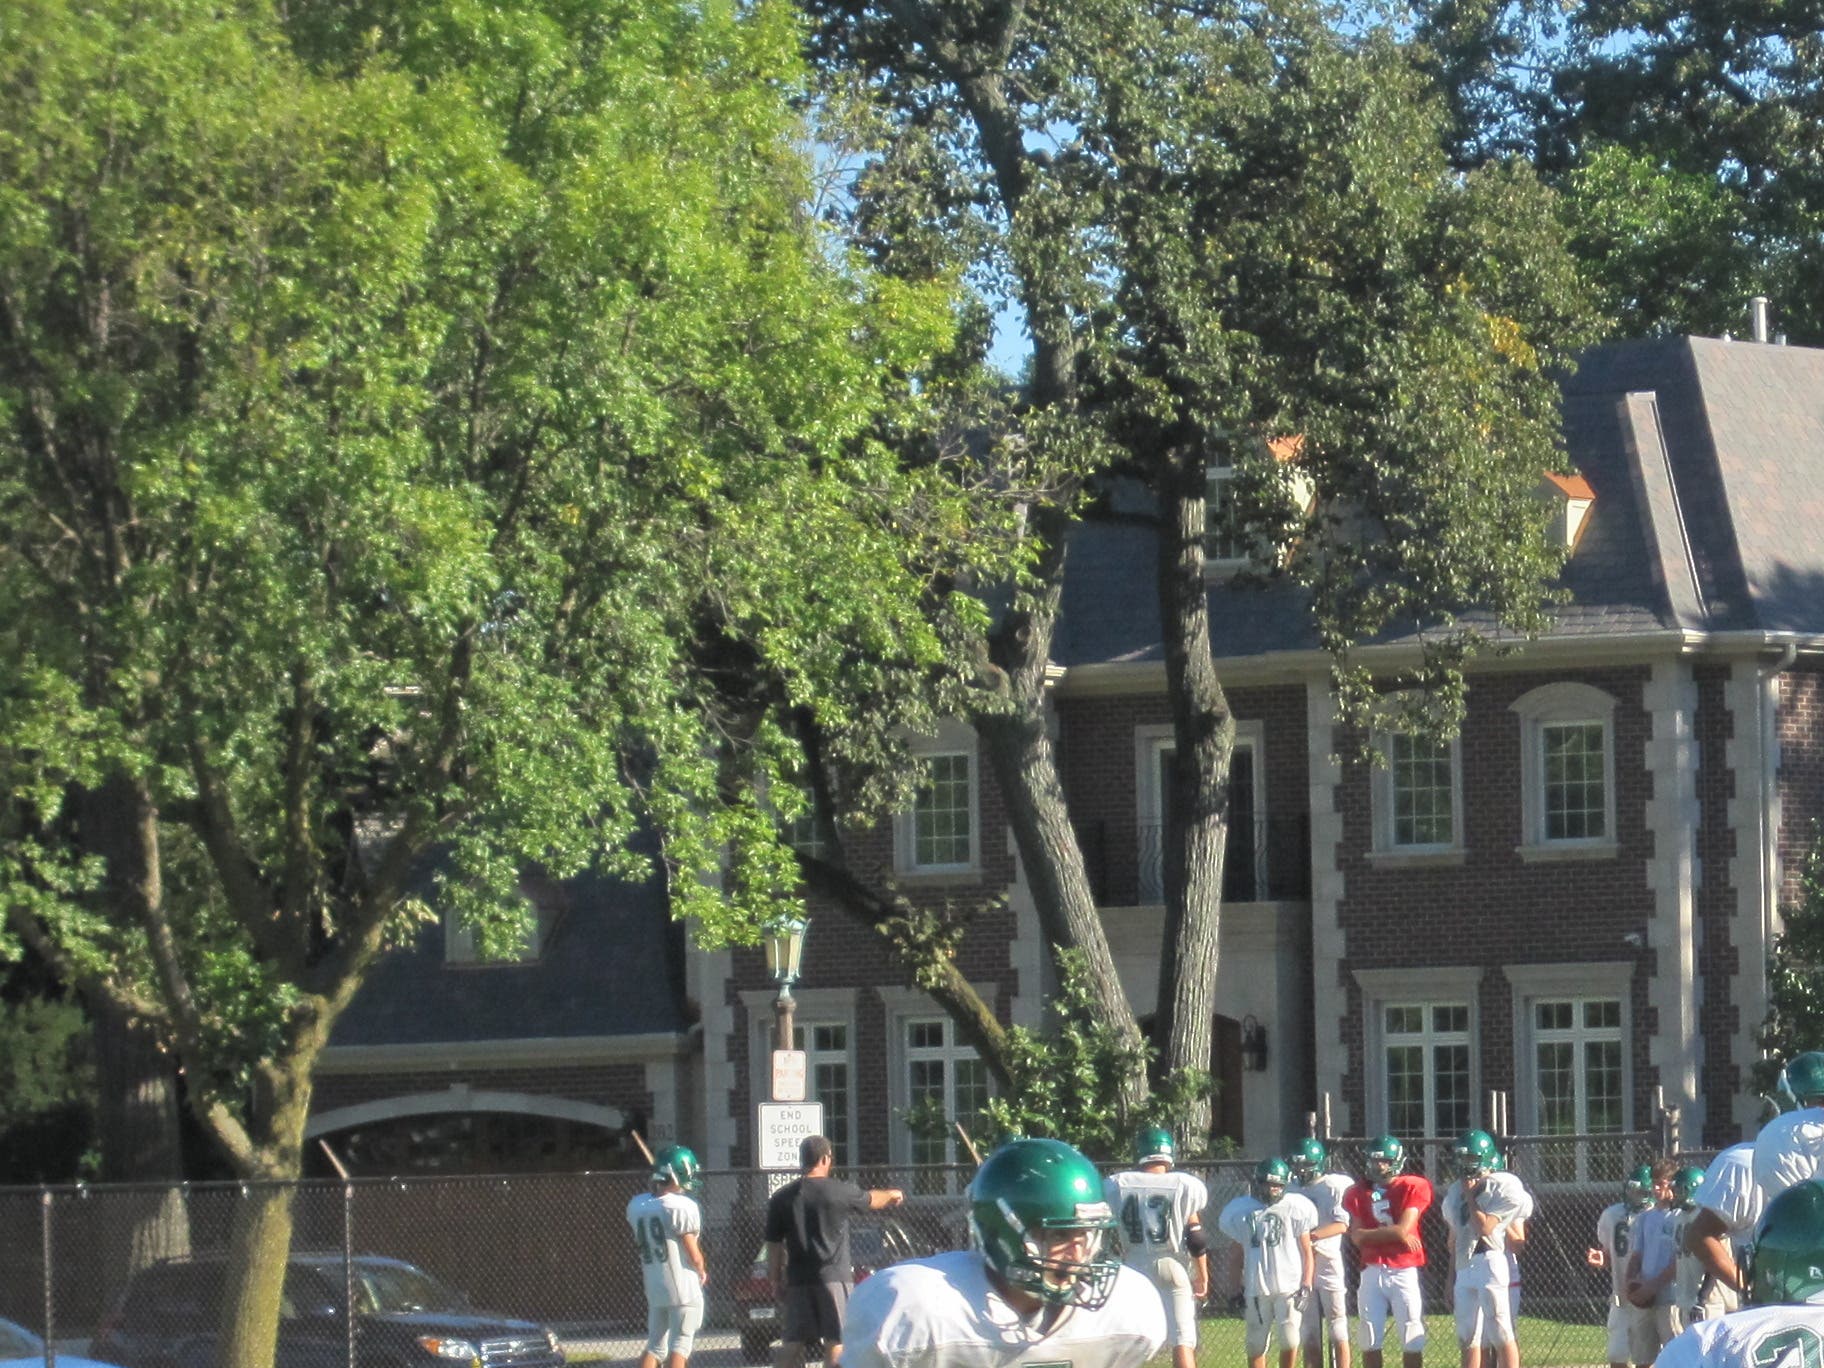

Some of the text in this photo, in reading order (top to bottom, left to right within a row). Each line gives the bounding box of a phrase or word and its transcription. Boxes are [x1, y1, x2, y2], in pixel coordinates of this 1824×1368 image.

[780, 1110, 802, 1120] END
[770, 1124, 812, 1134] SCHOOL
[775, 1138, 801, 1148] SPEE
[777, 1152, 798, 1162] ZON
[1121, 1193, 1172, 1244] 43
